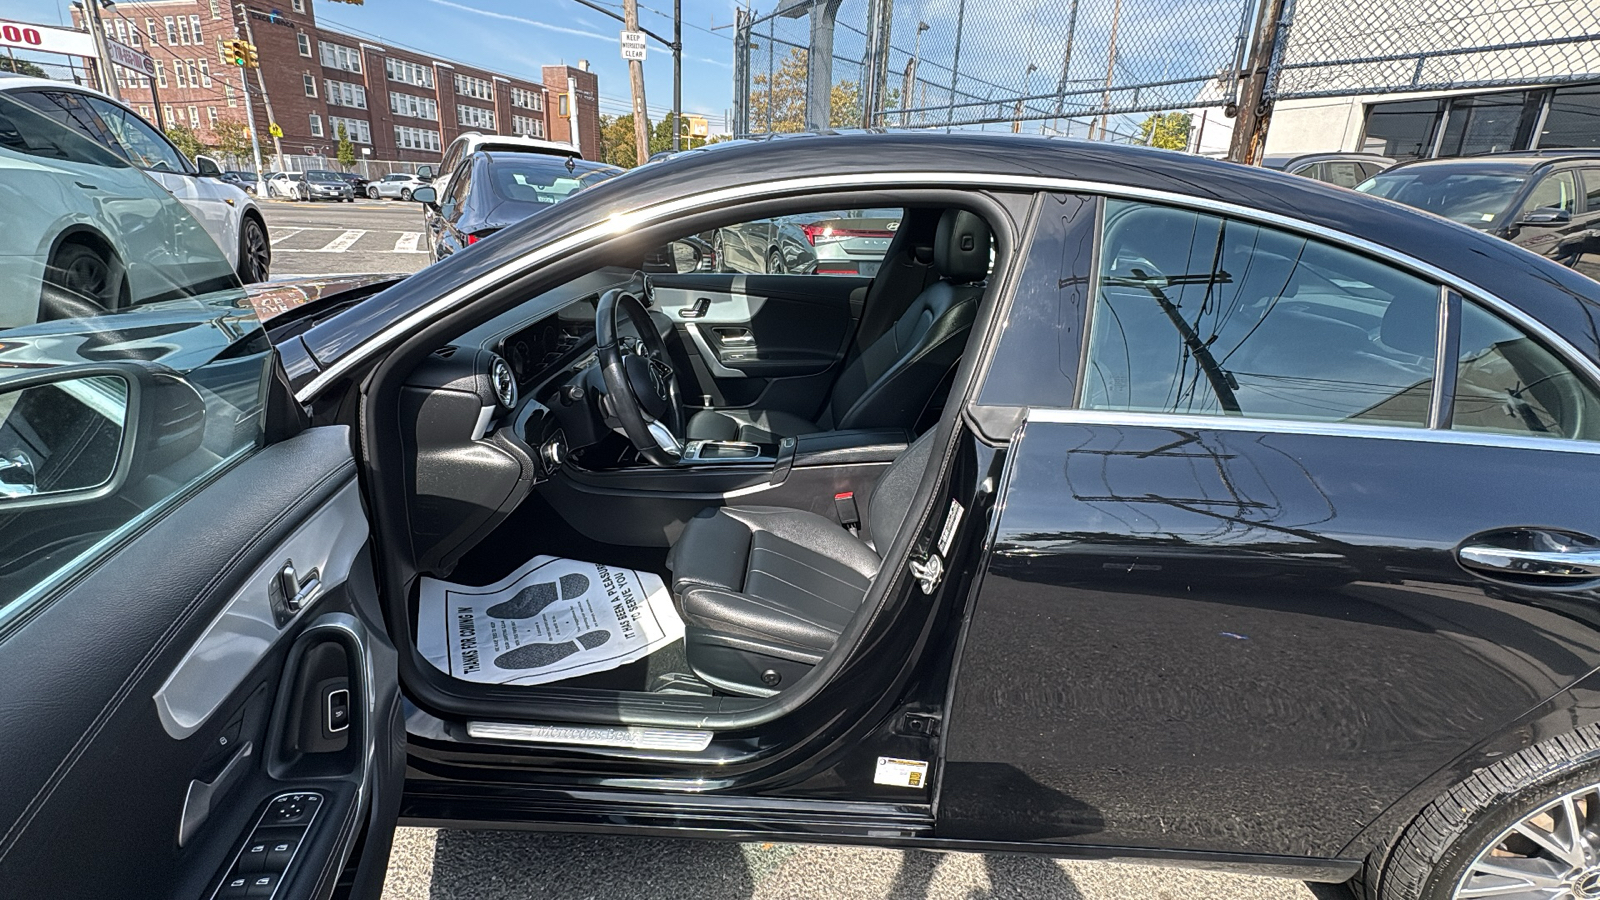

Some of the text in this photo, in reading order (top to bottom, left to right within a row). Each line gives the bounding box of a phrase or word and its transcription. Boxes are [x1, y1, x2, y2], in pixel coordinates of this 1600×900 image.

[0, 25, 42, 45] 00
[610, 595, 620, 603] A
[613, 572, 642, 622] TO SERVE YOU
[613, 602, 627, 621] BEEN
[620, 620, 633, 632] HAS
[457, 606, 481, 674] THANKS FOR COMING IN
[624, 632, 636, 640] IT
